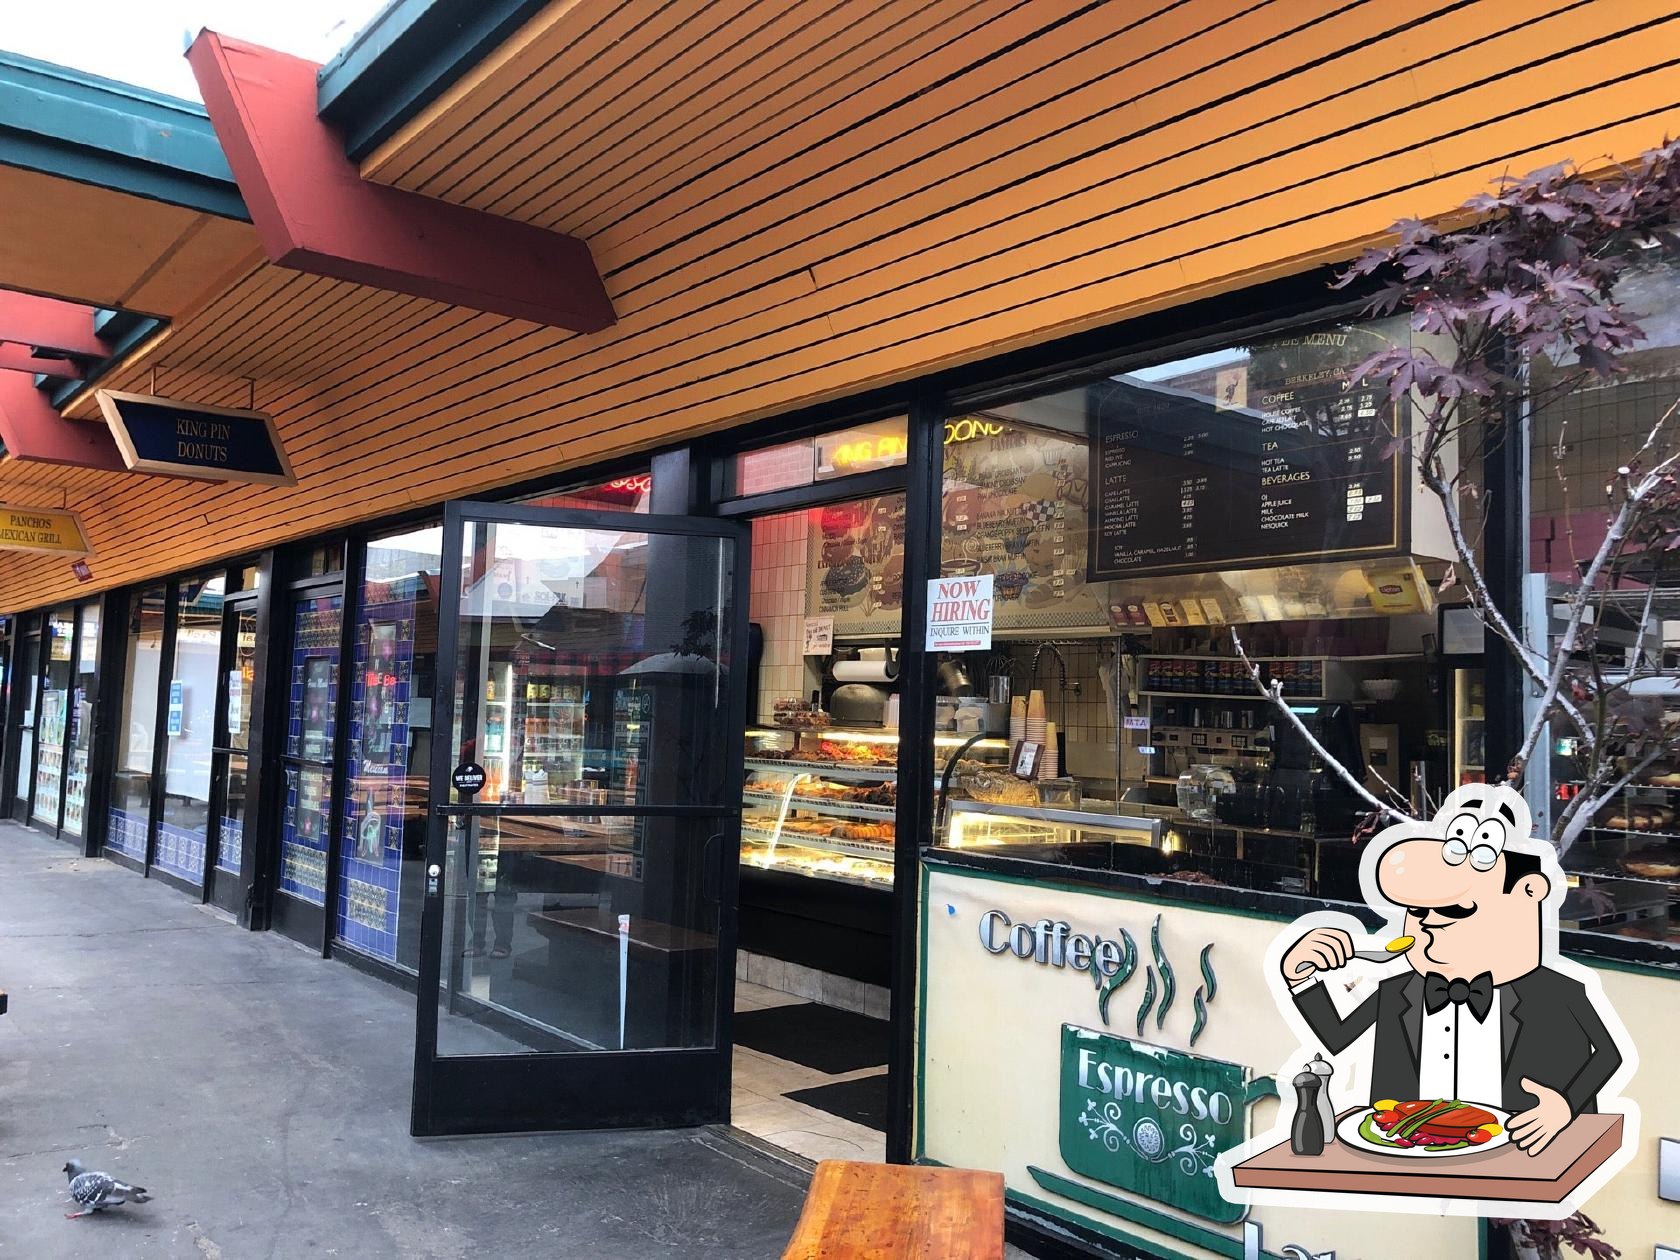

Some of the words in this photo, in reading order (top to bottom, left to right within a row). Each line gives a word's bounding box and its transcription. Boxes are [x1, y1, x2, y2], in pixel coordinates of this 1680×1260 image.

[1303, 333, 1348, 347] MENU
[1362, 378, 1369, 387] L
[1261, 391, 1295, 405] COFFEE
[176, 418, 207, 438] KING
[210, 423, 231, 440] PIN
[178, 441, 228, 462] DONUTS
[1262, 441, 1279, 451] TEA
[1105, 475, 1127, 485] LATTE
[1261, 471, 1311, 486] BEVERAGES
[1261, 514, 1295, 523] CHOCOLATE
[38, 532, 62, 545] GRILL
[937, 580, 981, 600] NOW
[931, 599, 991, 623] HIRING
[930, 626, 959, 638] INQUIRE
[962, 625, 990, 635] WITHIN
[978, 910, 1126, 976] Coffee
[1077, 1047, 1234, 1126] Espresso
